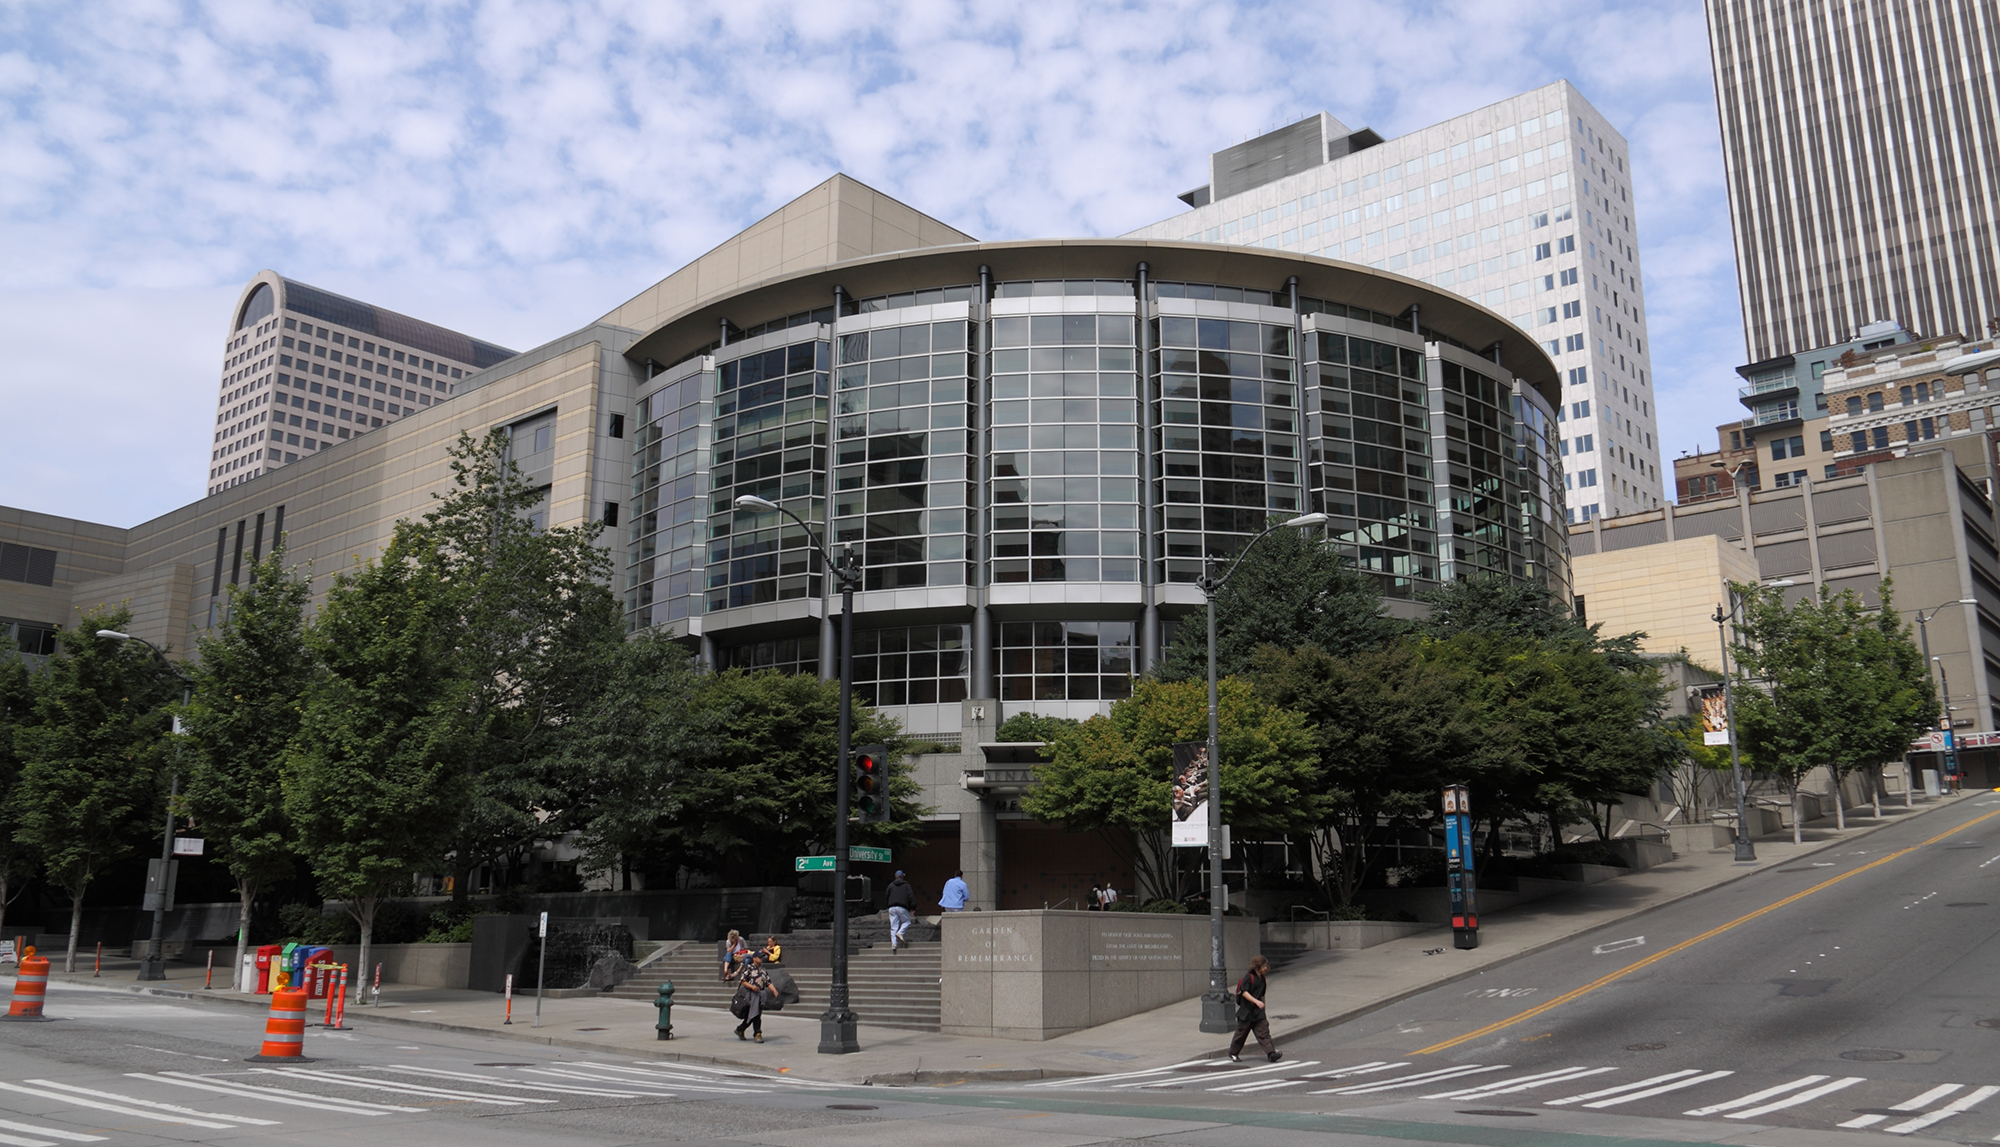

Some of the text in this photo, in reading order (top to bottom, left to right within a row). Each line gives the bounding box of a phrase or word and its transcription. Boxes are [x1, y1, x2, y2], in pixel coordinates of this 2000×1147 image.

[849, 848, 878, 860] University
[798, 858, 809, 869] 2nd
[957, 954, 1033, 962] REMEMBRANCE
